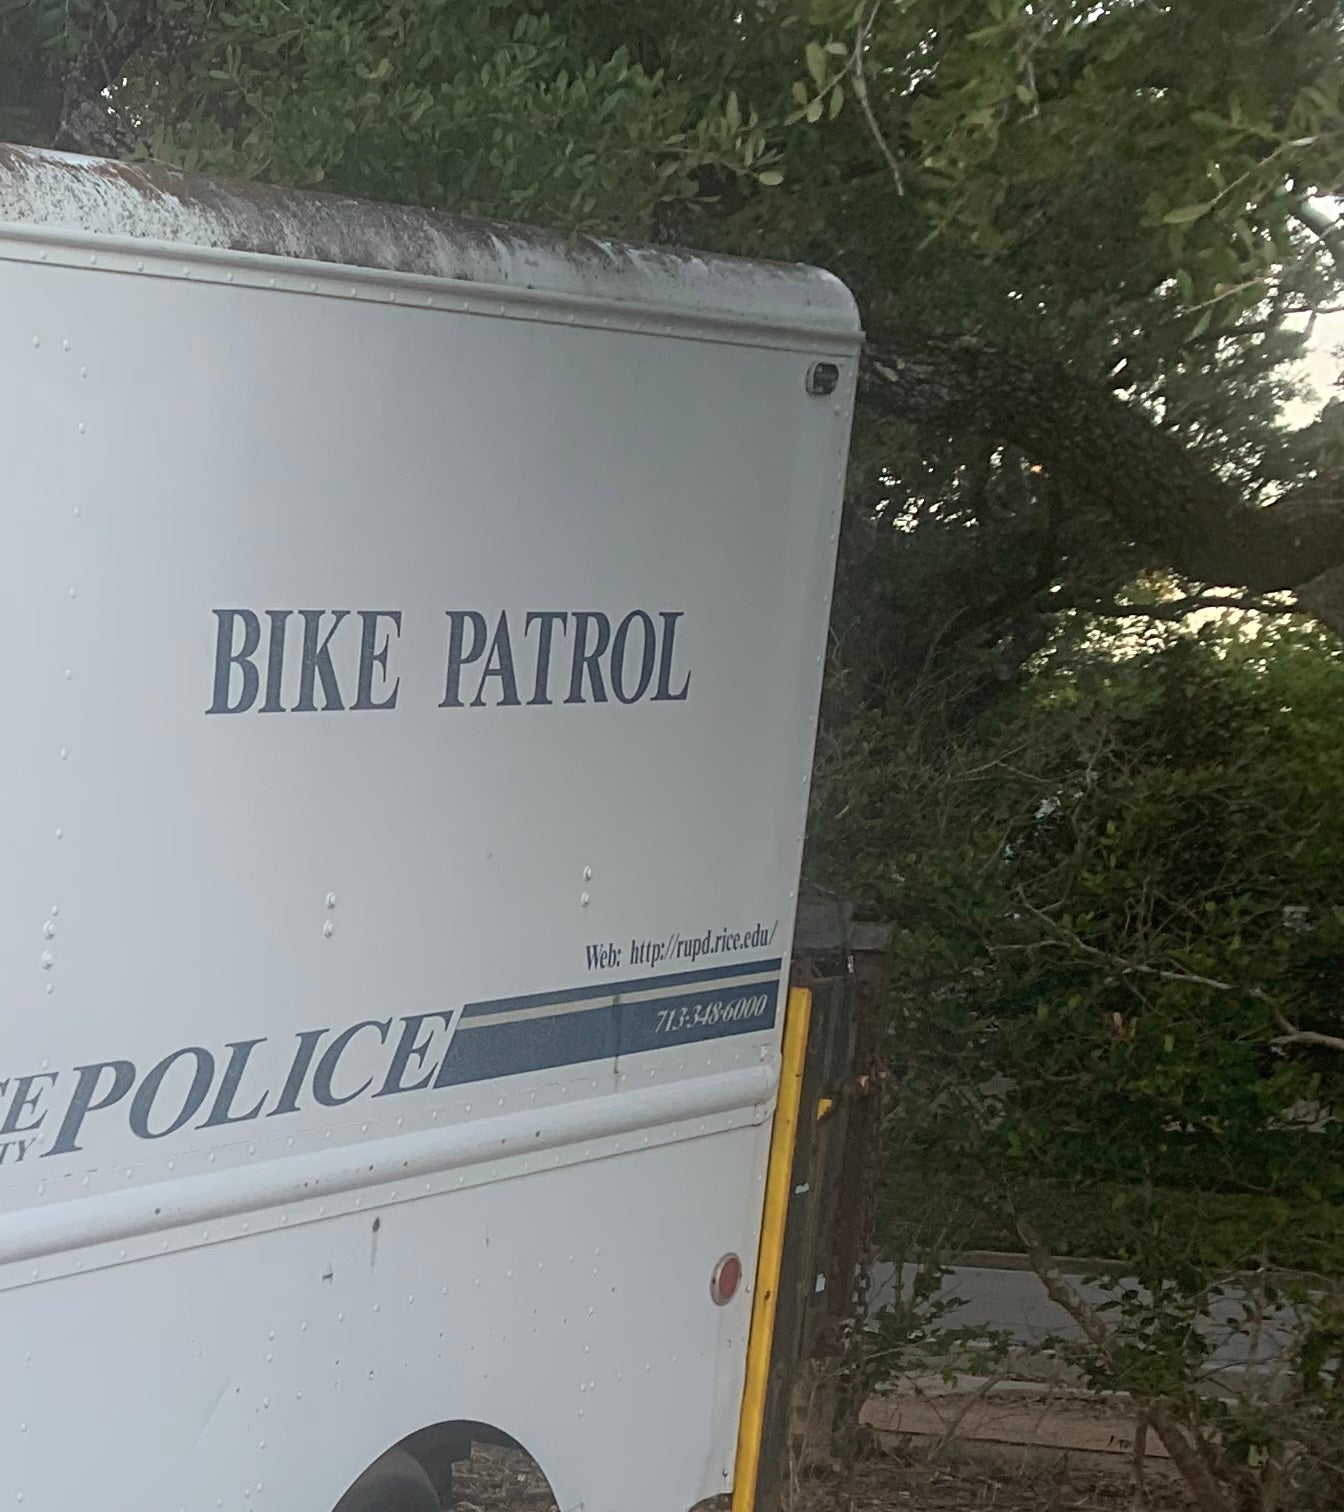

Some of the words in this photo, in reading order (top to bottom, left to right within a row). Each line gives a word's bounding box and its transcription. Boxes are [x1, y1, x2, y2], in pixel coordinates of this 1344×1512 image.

[205, 608, 402, 714] BIKE
[438, 608, 691, 708] PATROL
[585, 942, 621, 970] Web:
[629, 919, 779, 967] http://rupd.rice.edu/
[40, 1009, 456, 1159] POLICE
